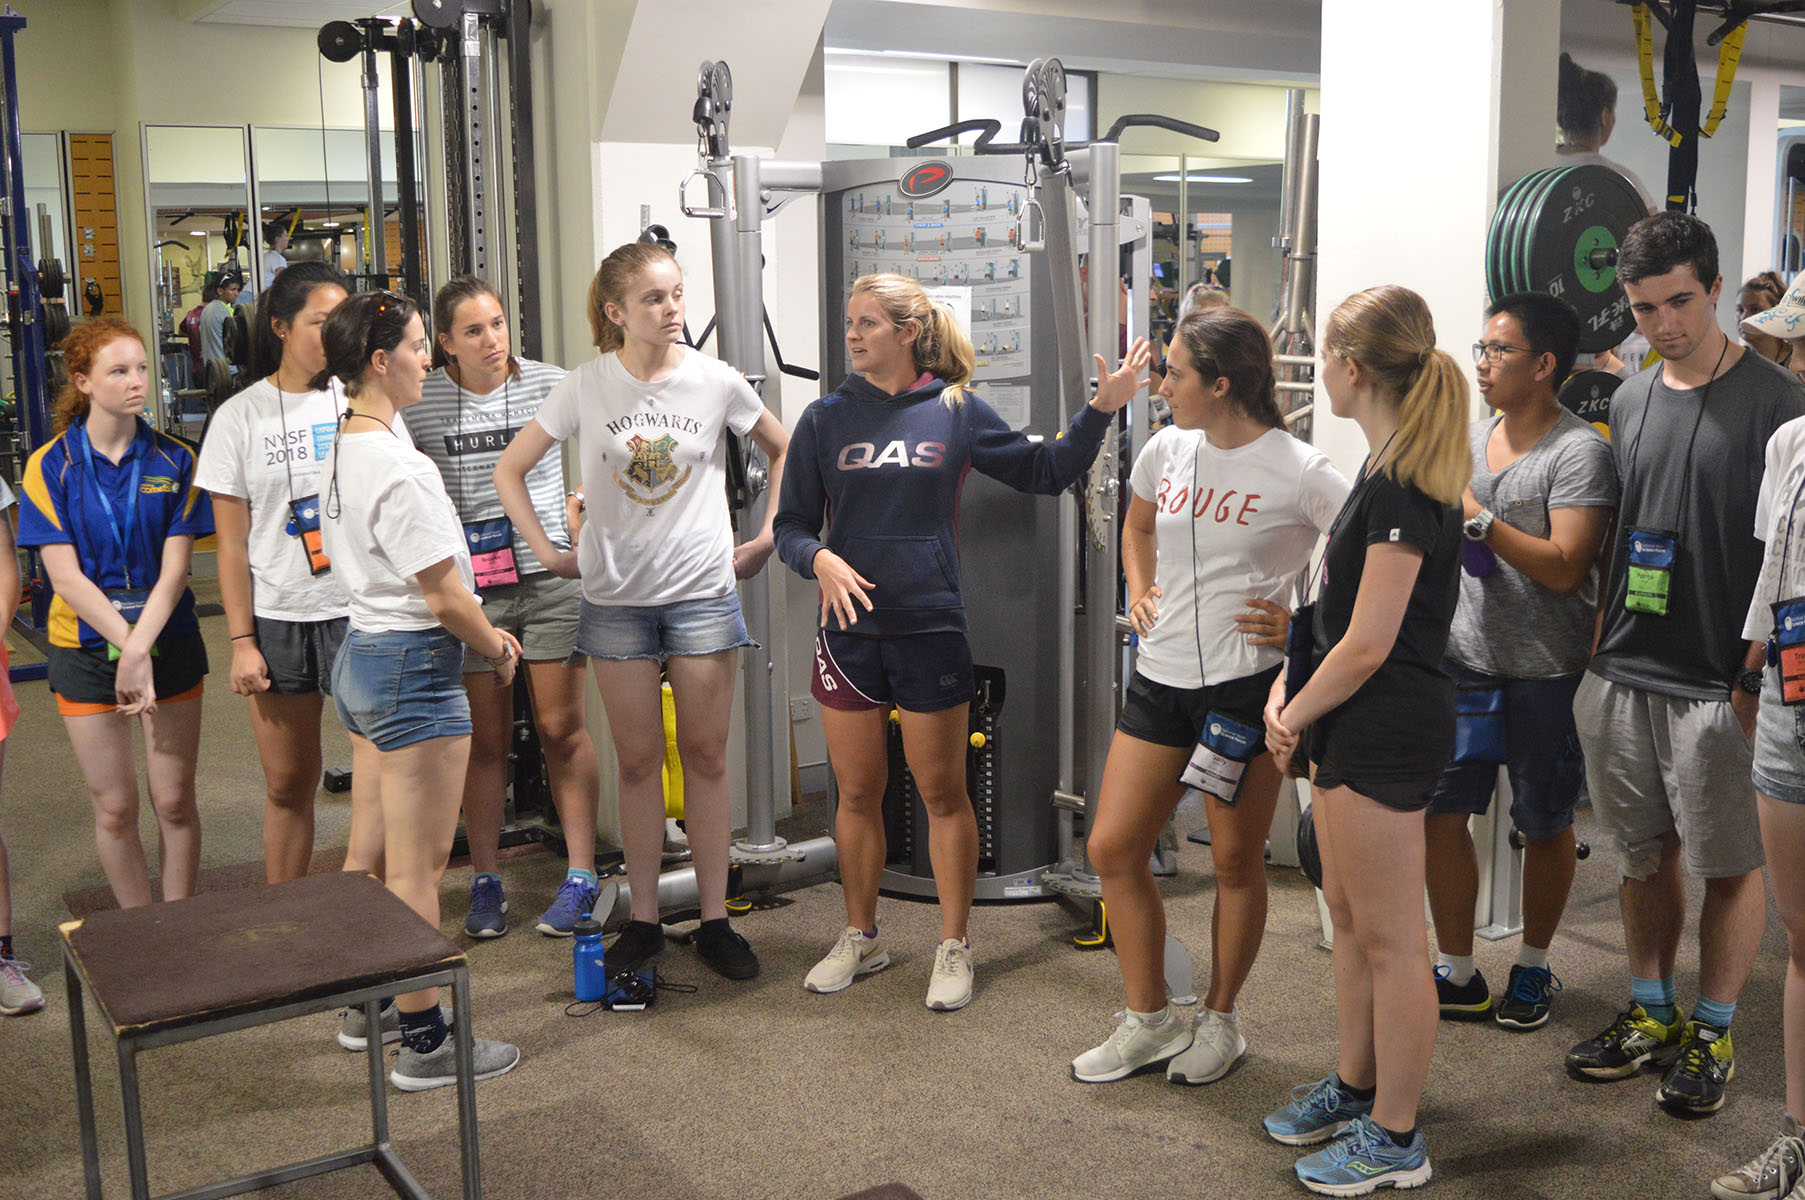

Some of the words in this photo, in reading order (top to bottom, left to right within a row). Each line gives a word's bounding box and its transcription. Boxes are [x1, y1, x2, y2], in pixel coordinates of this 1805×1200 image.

[1562, 192, 1595, 223] ZKC
[1577, 397, 1610, 414] ZKC
[441, 412, 498, 425] TRADEMARK
[606, 413, 702, 436] HOGWARTS
[264, 429, 308, 450] NYSF
[454, 432, 519, 451] HURL
[266, 446, 308, 466] 2018
[837, 440, 947, 471] QAS
[1157, 478, 1261, 526] ROUGE
[815, 636, 838, 692] QAS
